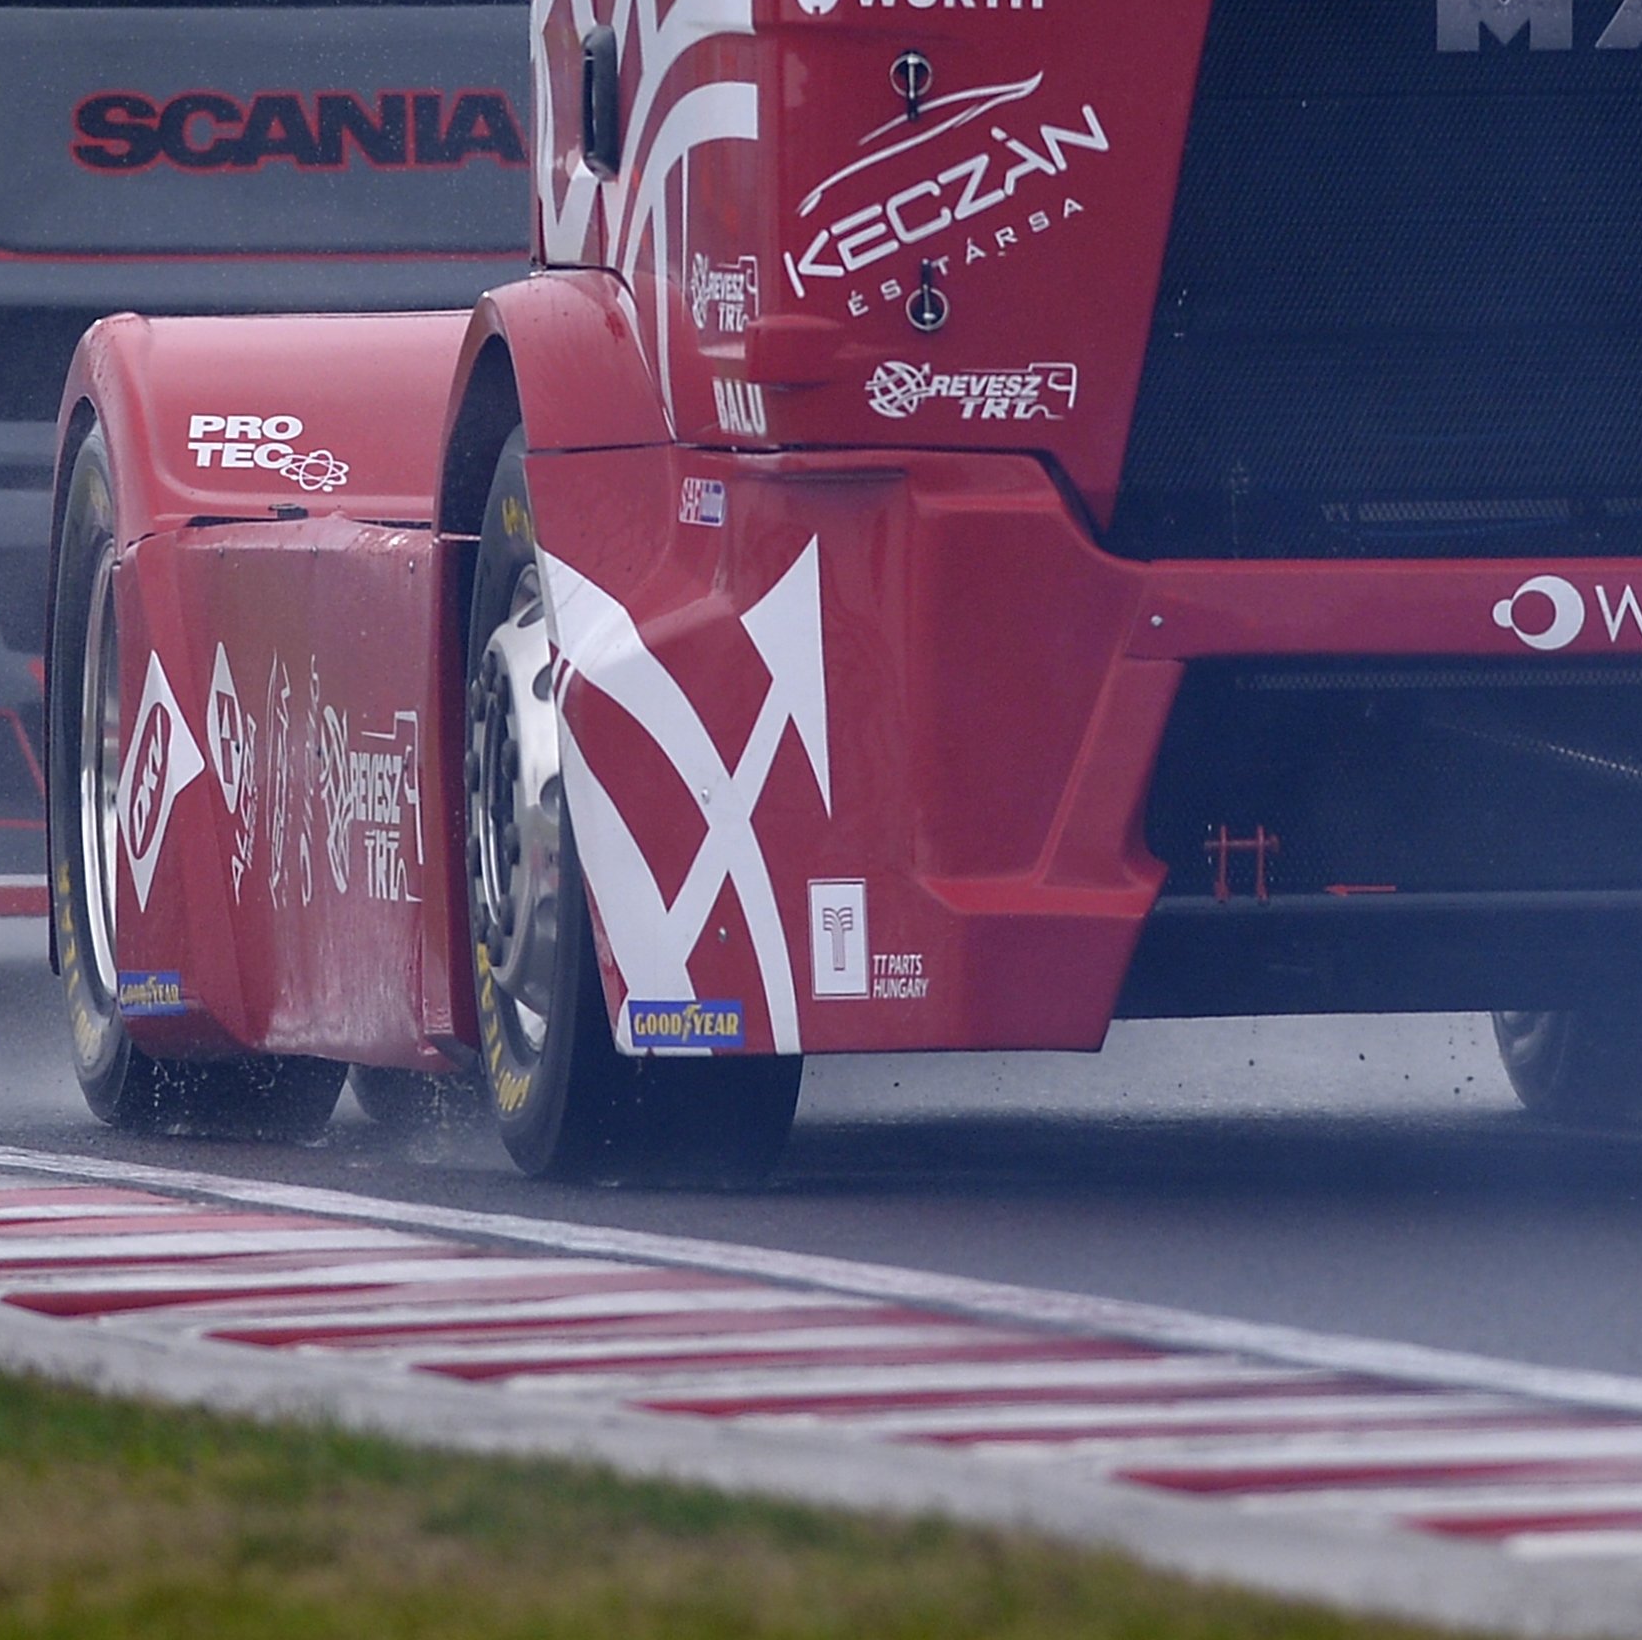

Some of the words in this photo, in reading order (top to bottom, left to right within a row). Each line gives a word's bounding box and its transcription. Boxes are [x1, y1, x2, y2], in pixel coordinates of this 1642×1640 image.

[68, 87, 532, 177] SCANIA
[928, 373, 1044, 398] REVESZ
[712, 376, 769, 437] BALU
[188, 415, 303, 440] PRO
[187, 441, 295, 468] TEC
[349, 750, 403, 824] REVESZ
[887, 954, 923, 976] PARTS
[872, 978, 929, 999] HUNGARY
[633, 1008, 739, 1039] GOODYEAR
